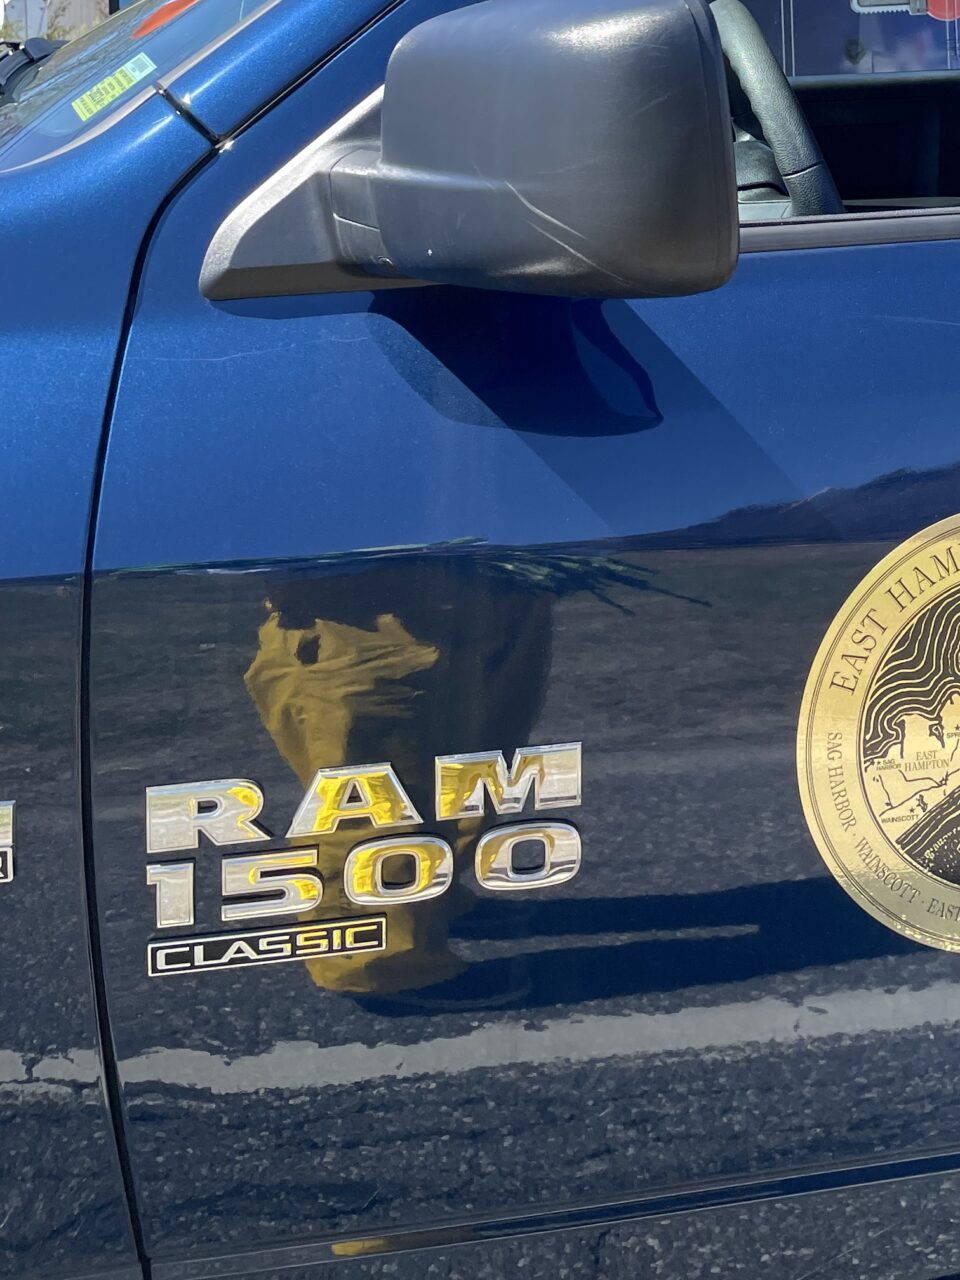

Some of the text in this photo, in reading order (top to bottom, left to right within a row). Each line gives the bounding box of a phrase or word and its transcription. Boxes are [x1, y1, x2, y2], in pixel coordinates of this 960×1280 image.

[829, 608, 888, 696] EAST
[826, 731, 857, 832] SAG HARBOR
[904, 759, 950, 772] HAMPTON
[916, 751, 938, 761] EAST
[146, 742, 582, 853] RAM
[146, 821, 582, 929] 1500
[855, 837, 921, 904] WAINSCOTT
[155, 924, 379, 970] CLASSIC
